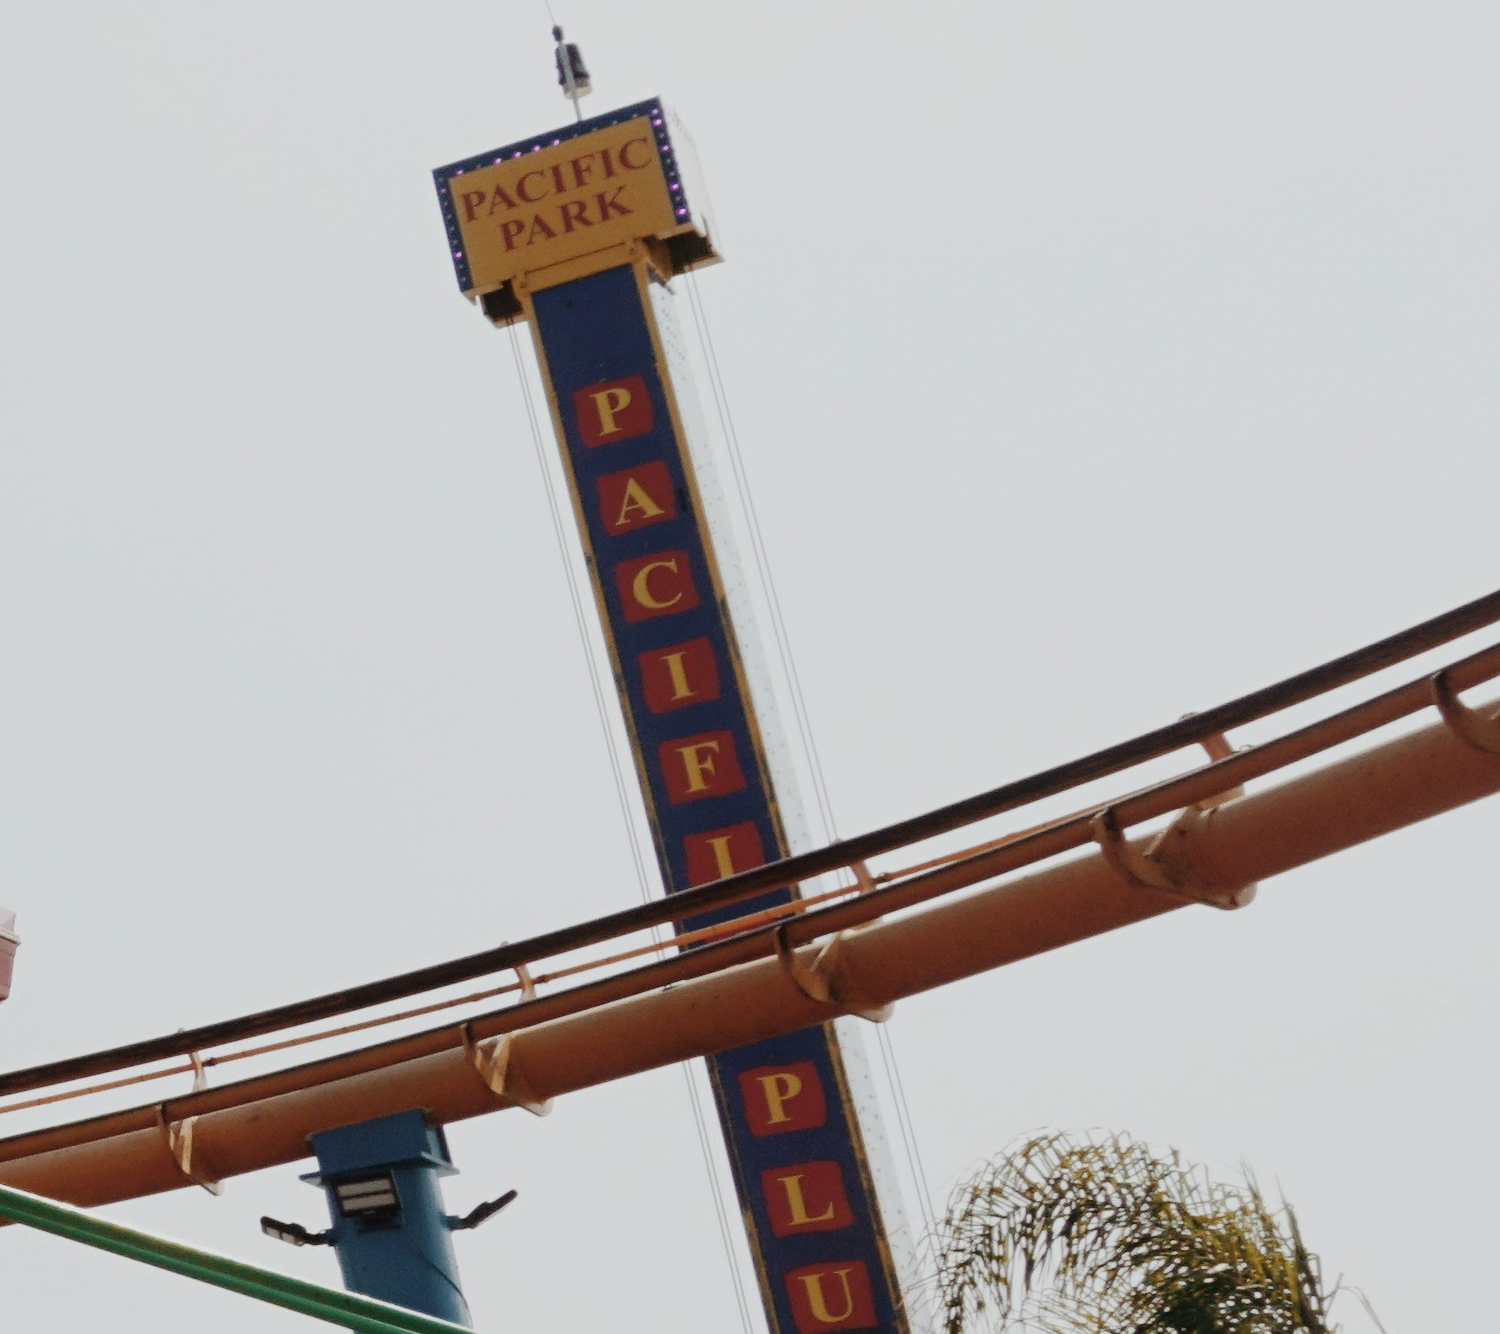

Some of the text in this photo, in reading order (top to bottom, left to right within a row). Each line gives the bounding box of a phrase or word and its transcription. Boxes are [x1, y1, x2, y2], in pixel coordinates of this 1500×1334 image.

[457, 137, 652, 223] PACIFIC
[500, 185, 634, 253] PARK
[590, 386, 736, 880] PACIFI
